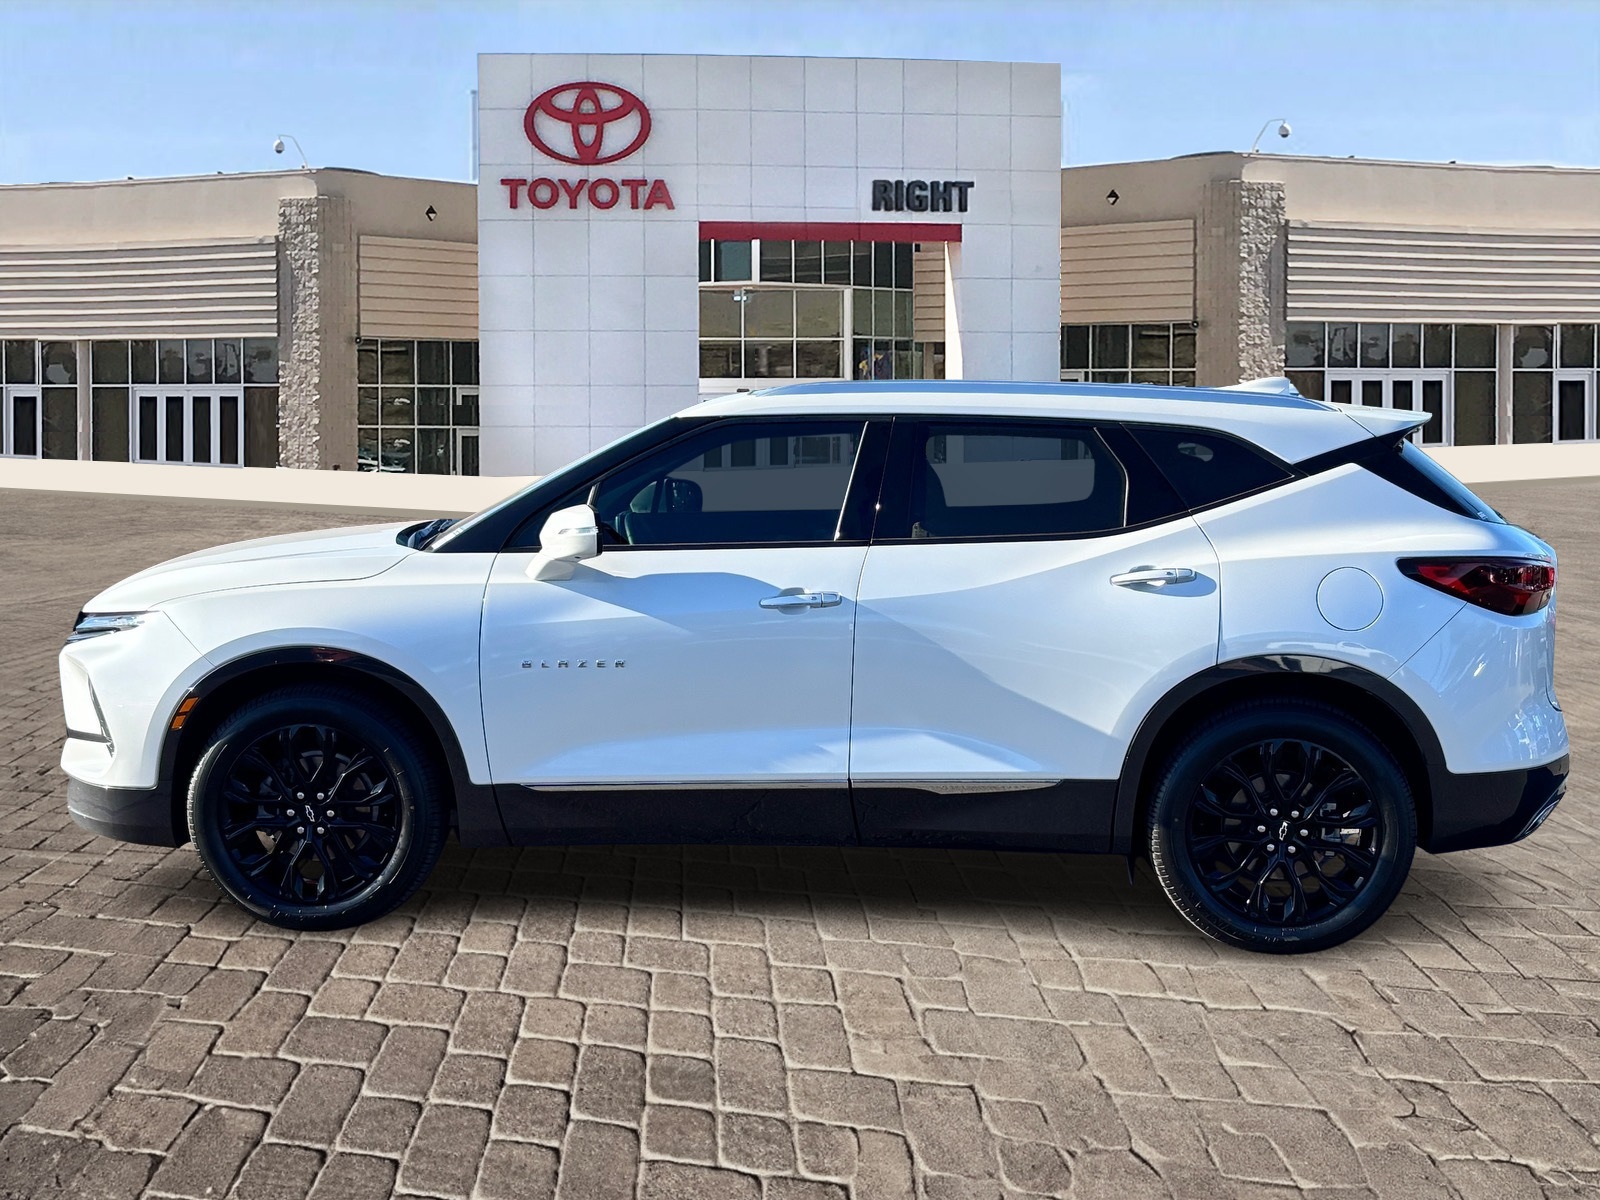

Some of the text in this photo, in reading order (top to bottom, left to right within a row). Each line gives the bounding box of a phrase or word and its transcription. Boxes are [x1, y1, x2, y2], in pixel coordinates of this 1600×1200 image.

[500, 178, 675, 210] TOYOTA
[872, 180, 975, 212] RIGHT
[521, 659, 625, 669] BLAZER
